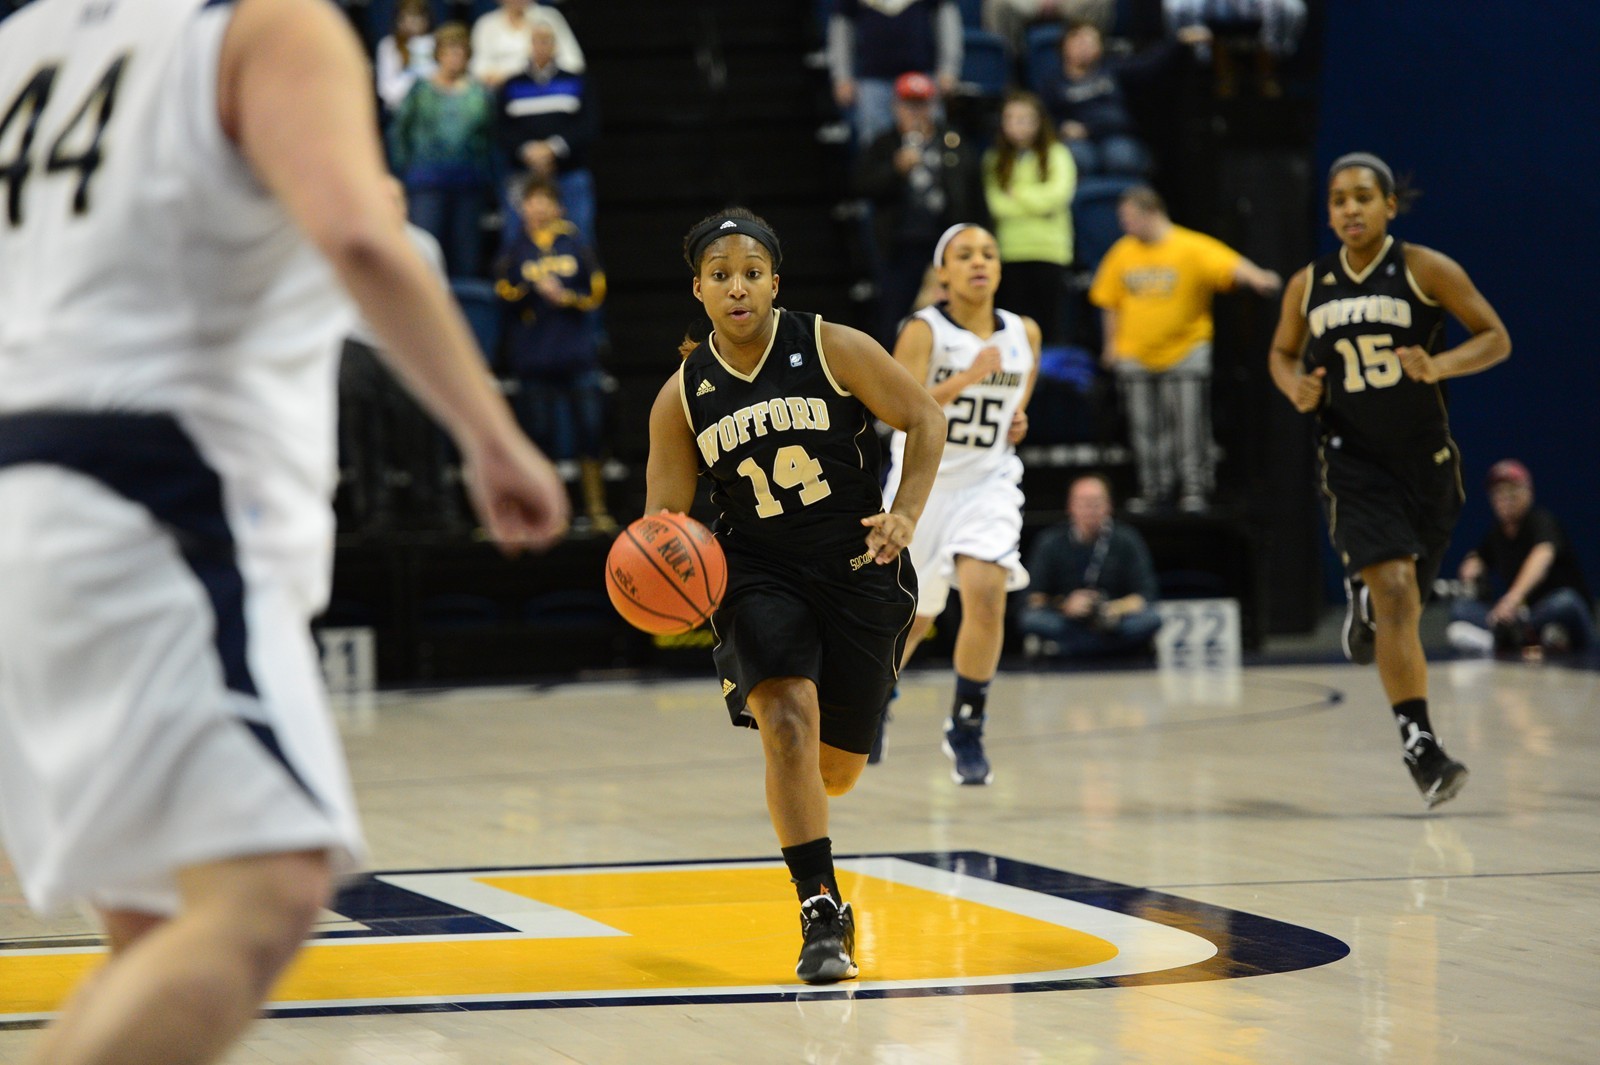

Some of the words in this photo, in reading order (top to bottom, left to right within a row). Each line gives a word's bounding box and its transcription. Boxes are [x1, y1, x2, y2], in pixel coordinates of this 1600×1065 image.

[1309, 295, 1412, 338] WOFFORD
[1334, 333, 1402, 393] 15
[697, 397, 830, 468] WOFFORD
[946, 395, 1004, 449] 25
[736, 445, 832, 518] 14
[657, 535, 695, 585] ROCK
